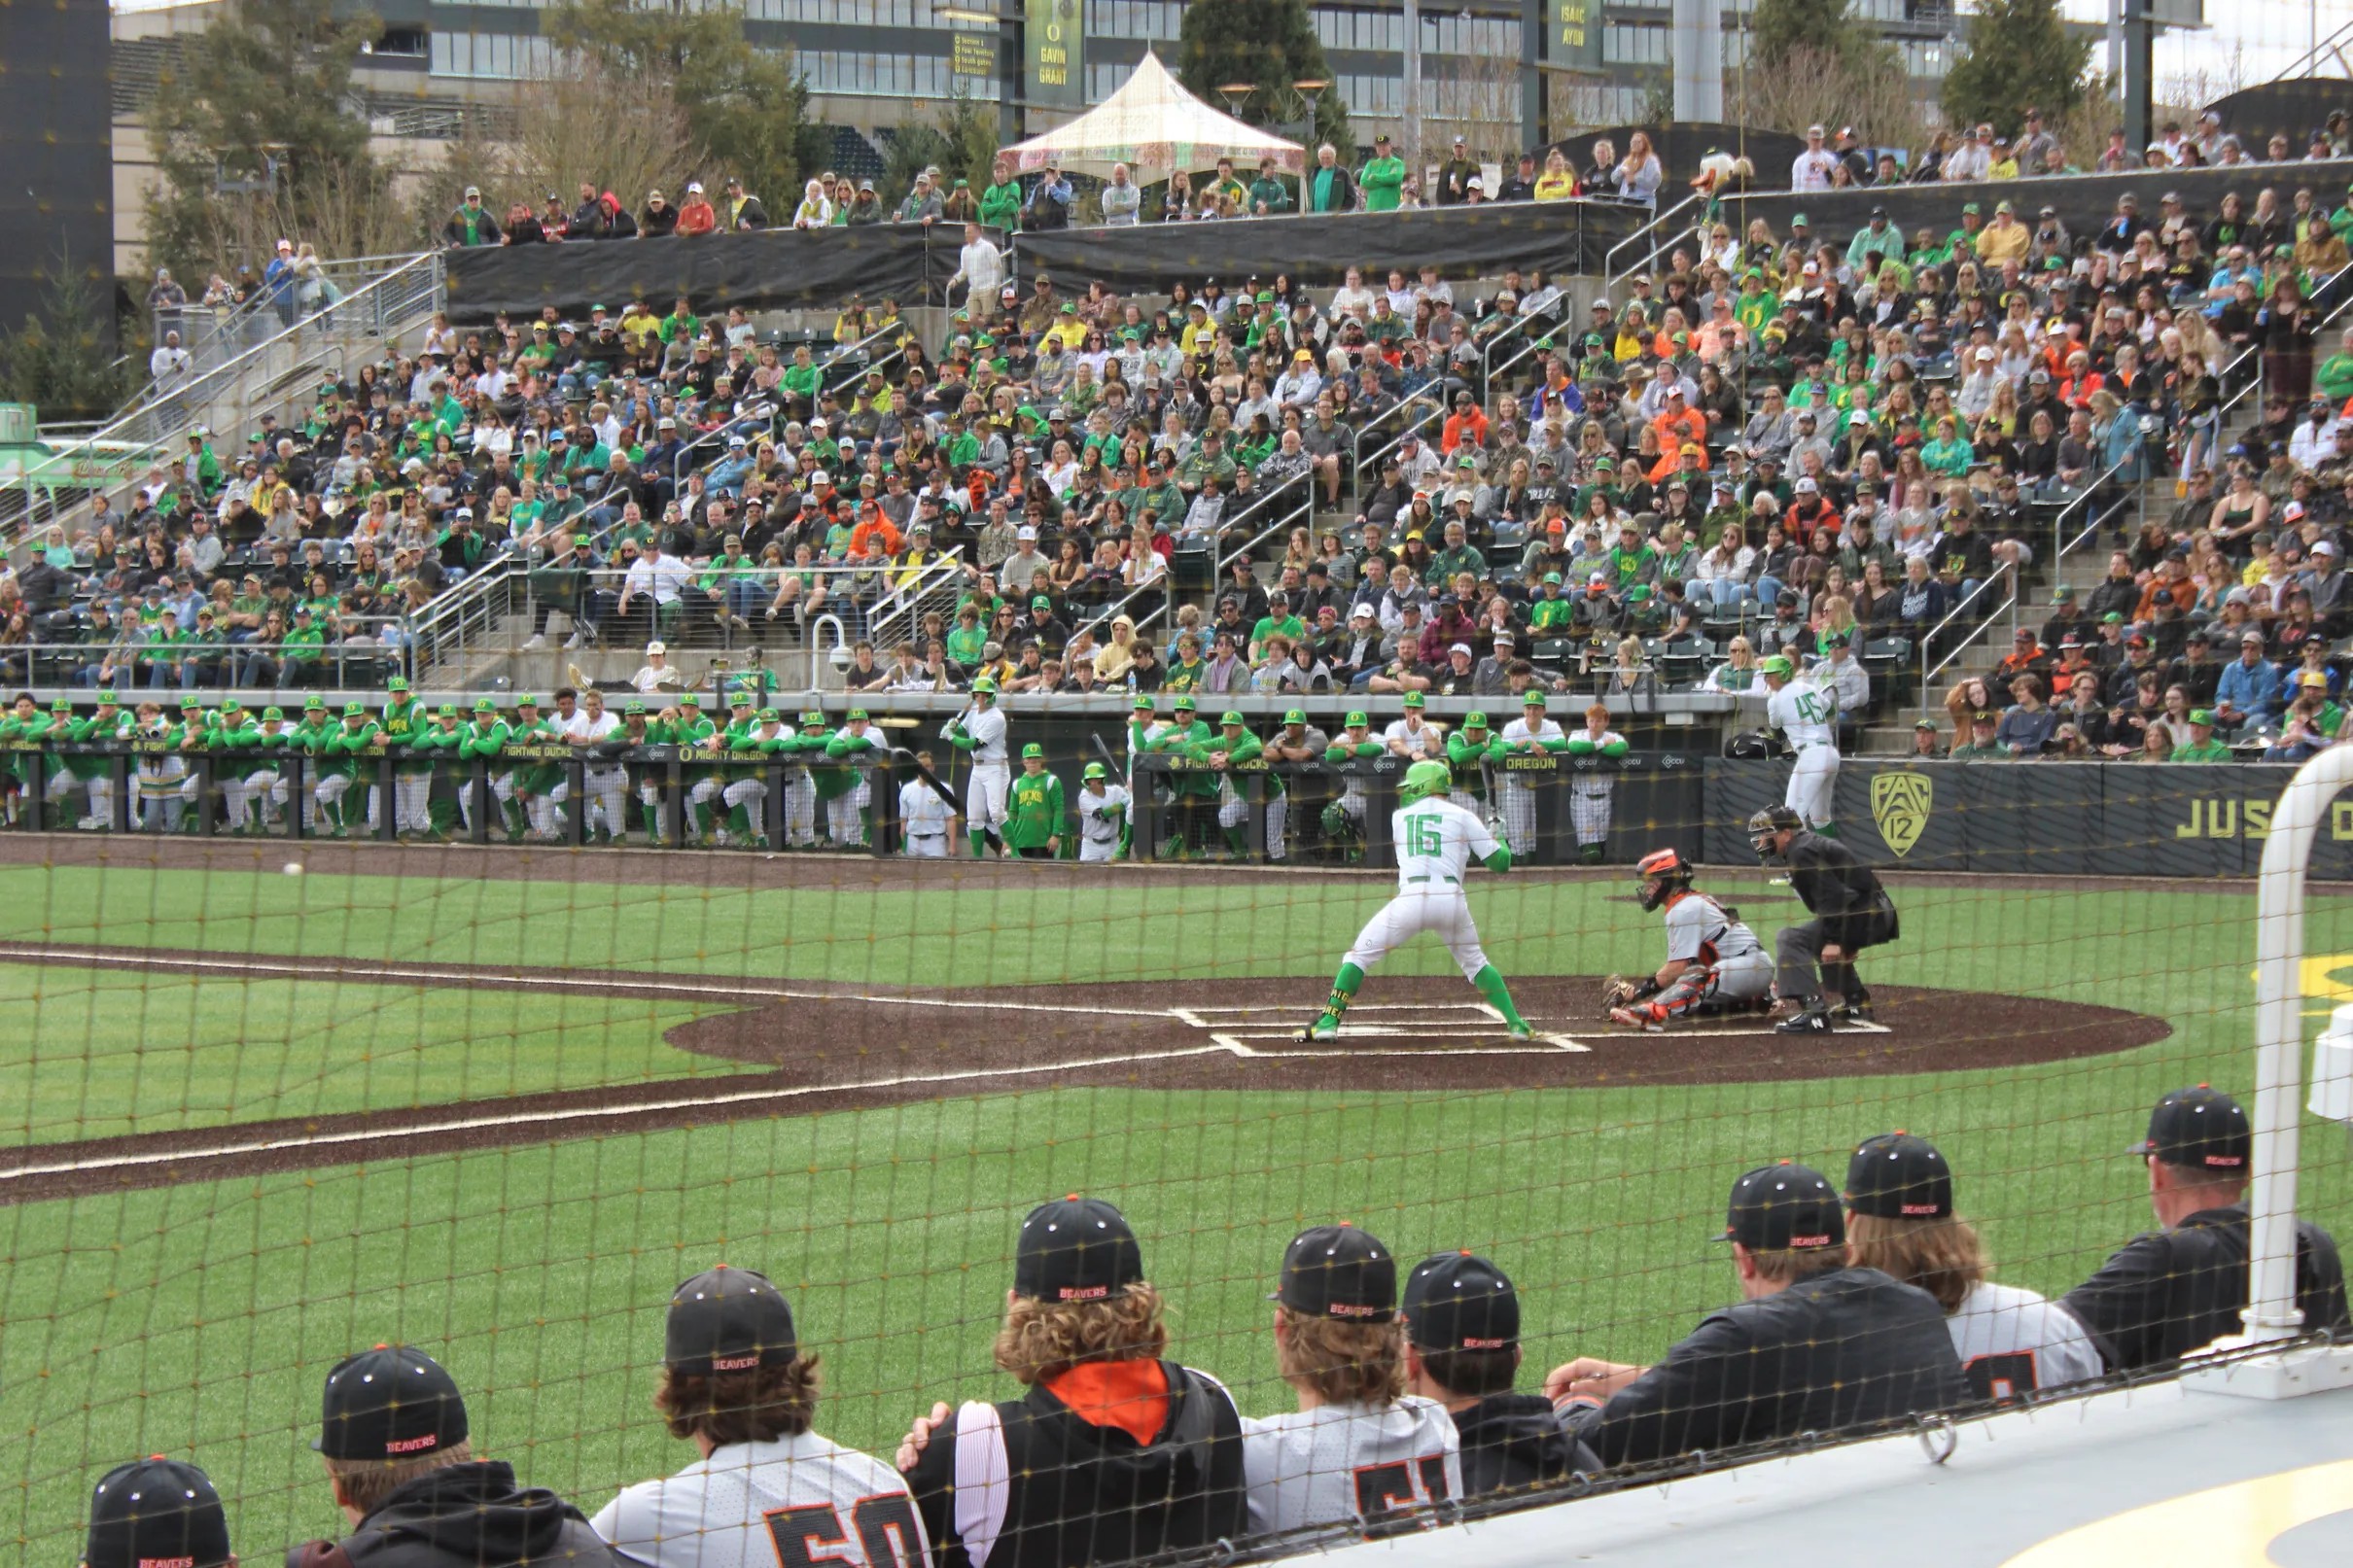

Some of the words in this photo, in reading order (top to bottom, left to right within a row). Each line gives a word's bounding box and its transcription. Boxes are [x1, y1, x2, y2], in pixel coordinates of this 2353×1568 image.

[1040, 48, 1067, 64] GAVIN
[1038, 67, 1068, 86] GRANT
[1795, 691, 1827, 725] 45
[503, 746, 541, 756] FIGHTING
[544, 747, 573, 757] DUCKS
[695, 749, 728, 760] MIGHTY
[731, 750, 768, 760] OREGON
[1375, 760, 1395, 771] OCCU
[1506, 758, 1557, 770] OREGON
[1663, 756, 1685, 767] OCCU
[1873, 776, 1929, 824] PAC
[2176, 799, 2272, 839] JUS
[1403, 814, 1444, 857] 16
[1890, 817, 1913, 840] 12
[1901, 1203, 1938, 1214] BEAVERS
[1790, 1235, 1830, 1246] BEAVERS
[1059, 1285, 1106, 1299] BEAVERS
[1330, 1303, 1374, 1316] BEAVERS
[713, 1356, 760, 1371] BEAVERS
[386, 1434, 437, 1454] BEAVERS
